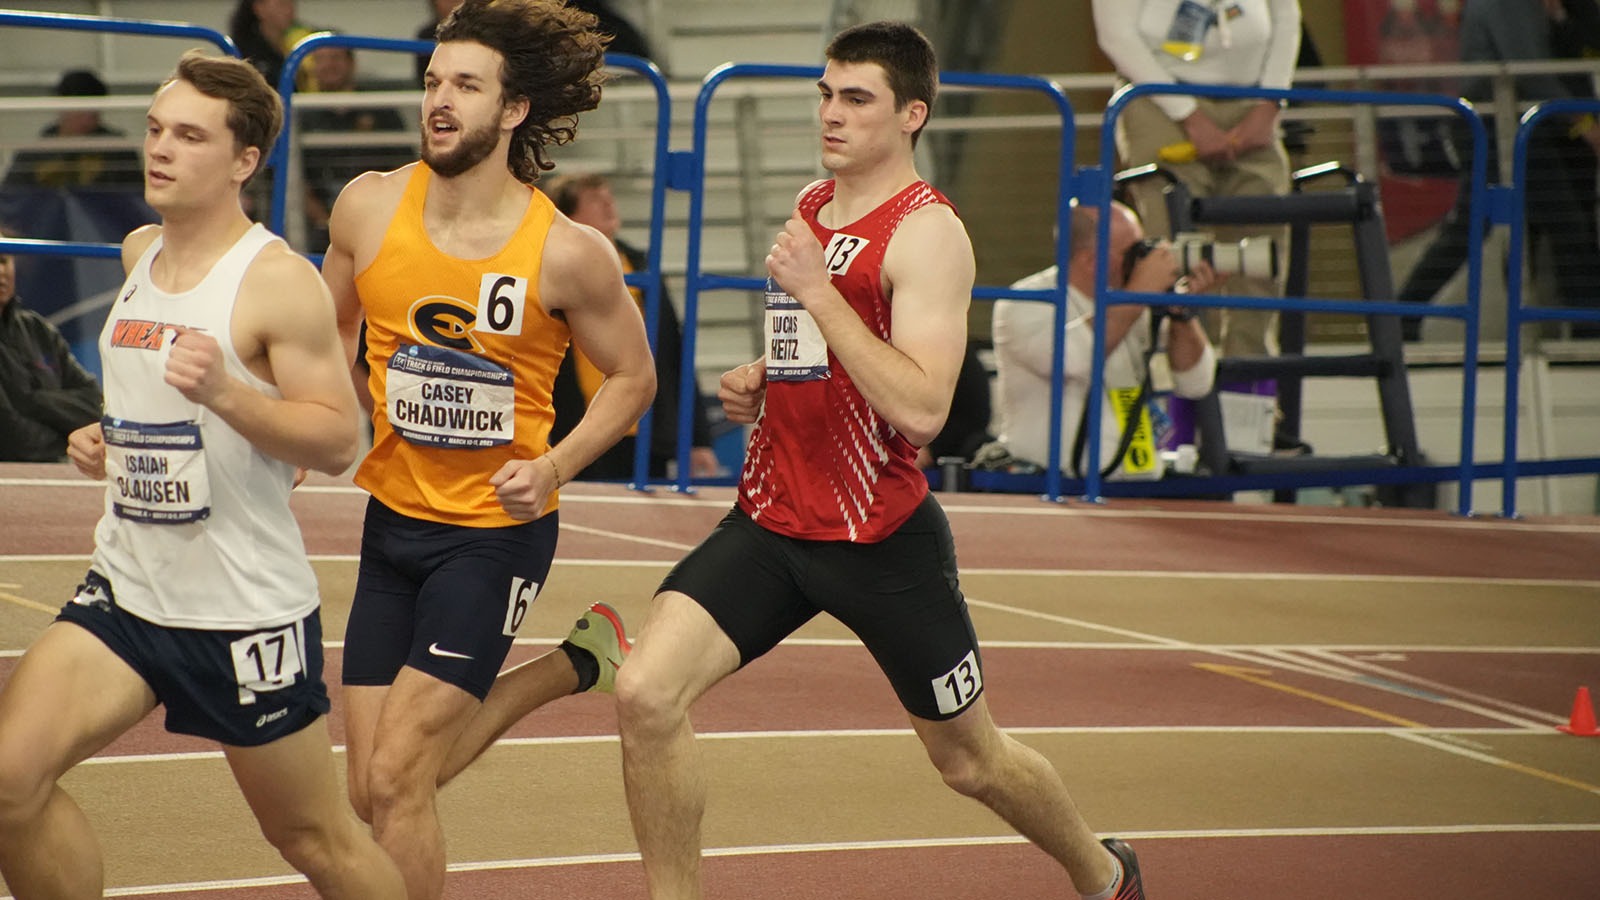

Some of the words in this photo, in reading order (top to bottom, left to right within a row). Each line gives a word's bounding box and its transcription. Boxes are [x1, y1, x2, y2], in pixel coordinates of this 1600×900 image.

[827, 236, 860, 272] 13
[486, 275, 517, 332] 6
[110, 318, 188, 352] WHEA
[772, 316, 798, 334] LUCAS
[771, 339, 799, 361] HEITZ
[406, 359, 426, 372] TRACK
[431, 364, 451, 375] FIELD
[451, 367, 509, 381] CHAMPIONSHIPS
[421, 382, 474, 405] CASEY
[395, 398, 503, 432] CHADWICK
[125, 454, 169, 475] ISAIAH
[511, 580, 533, 633] 6
[246, 634, 285, 684] 17
[945, 660, 976, 706] 13
